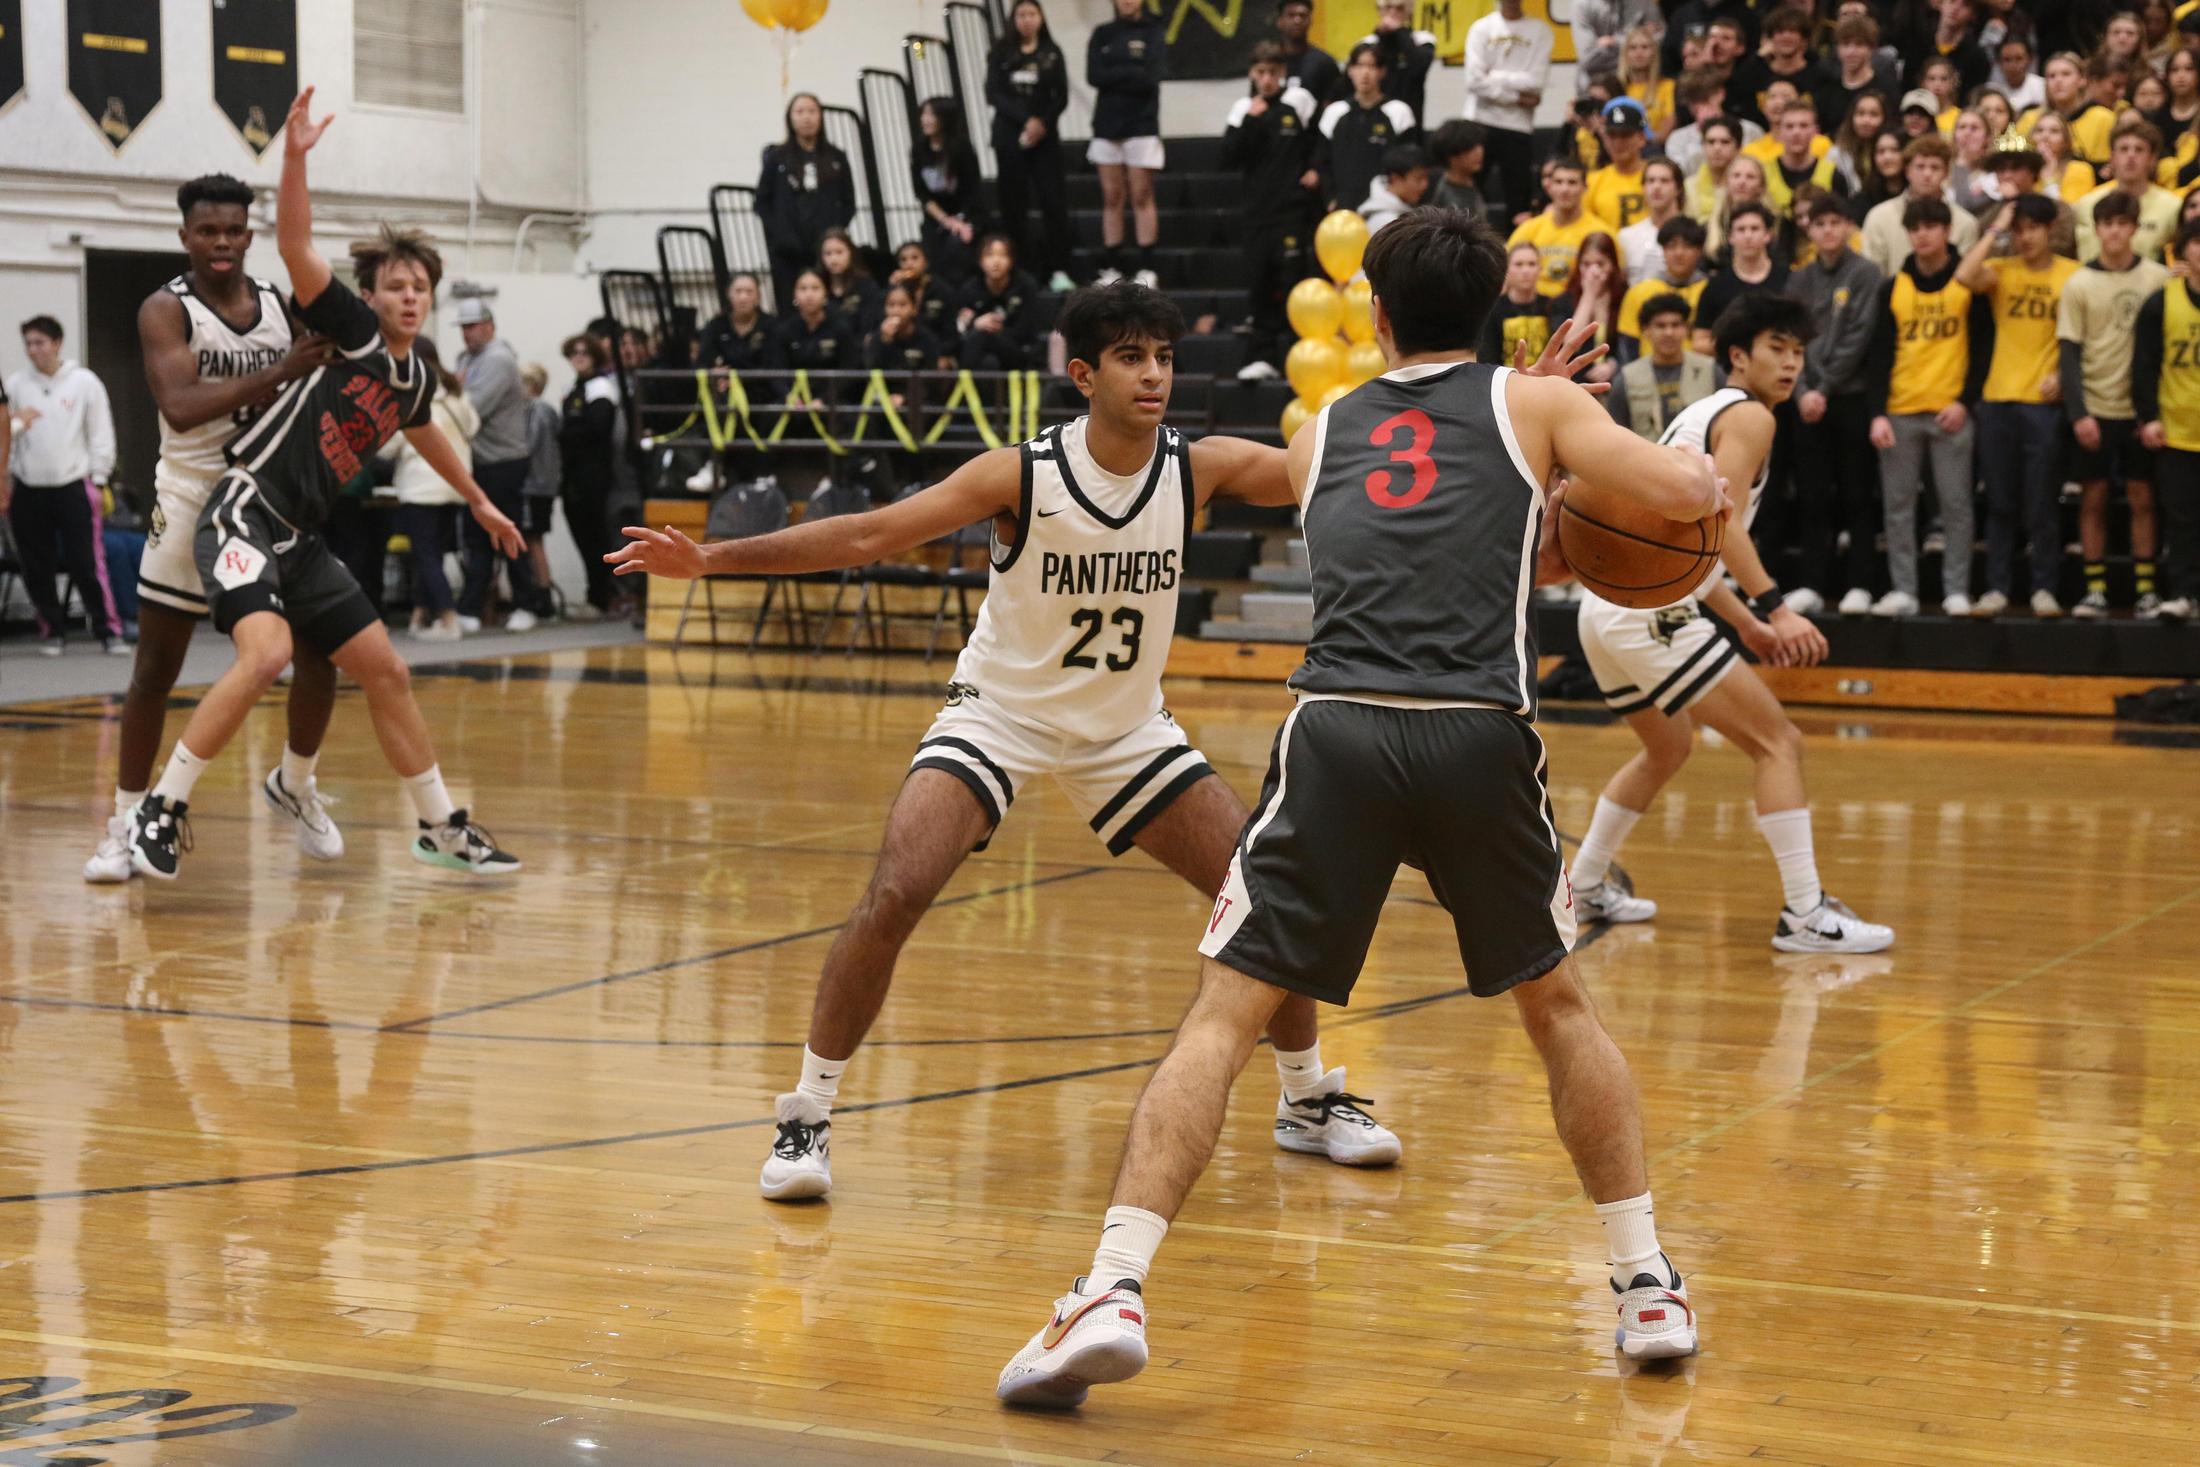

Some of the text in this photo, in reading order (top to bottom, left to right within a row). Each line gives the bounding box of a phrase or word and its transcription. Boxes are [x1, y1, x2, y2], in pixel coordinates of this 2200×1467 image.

[1903, 316, 1959, 341] ZOO
[1364, 408, 1440, 509] 3
[1041, 549, 1177, 595] PANTHERS
[1062, 606, 1144, 672] 23
